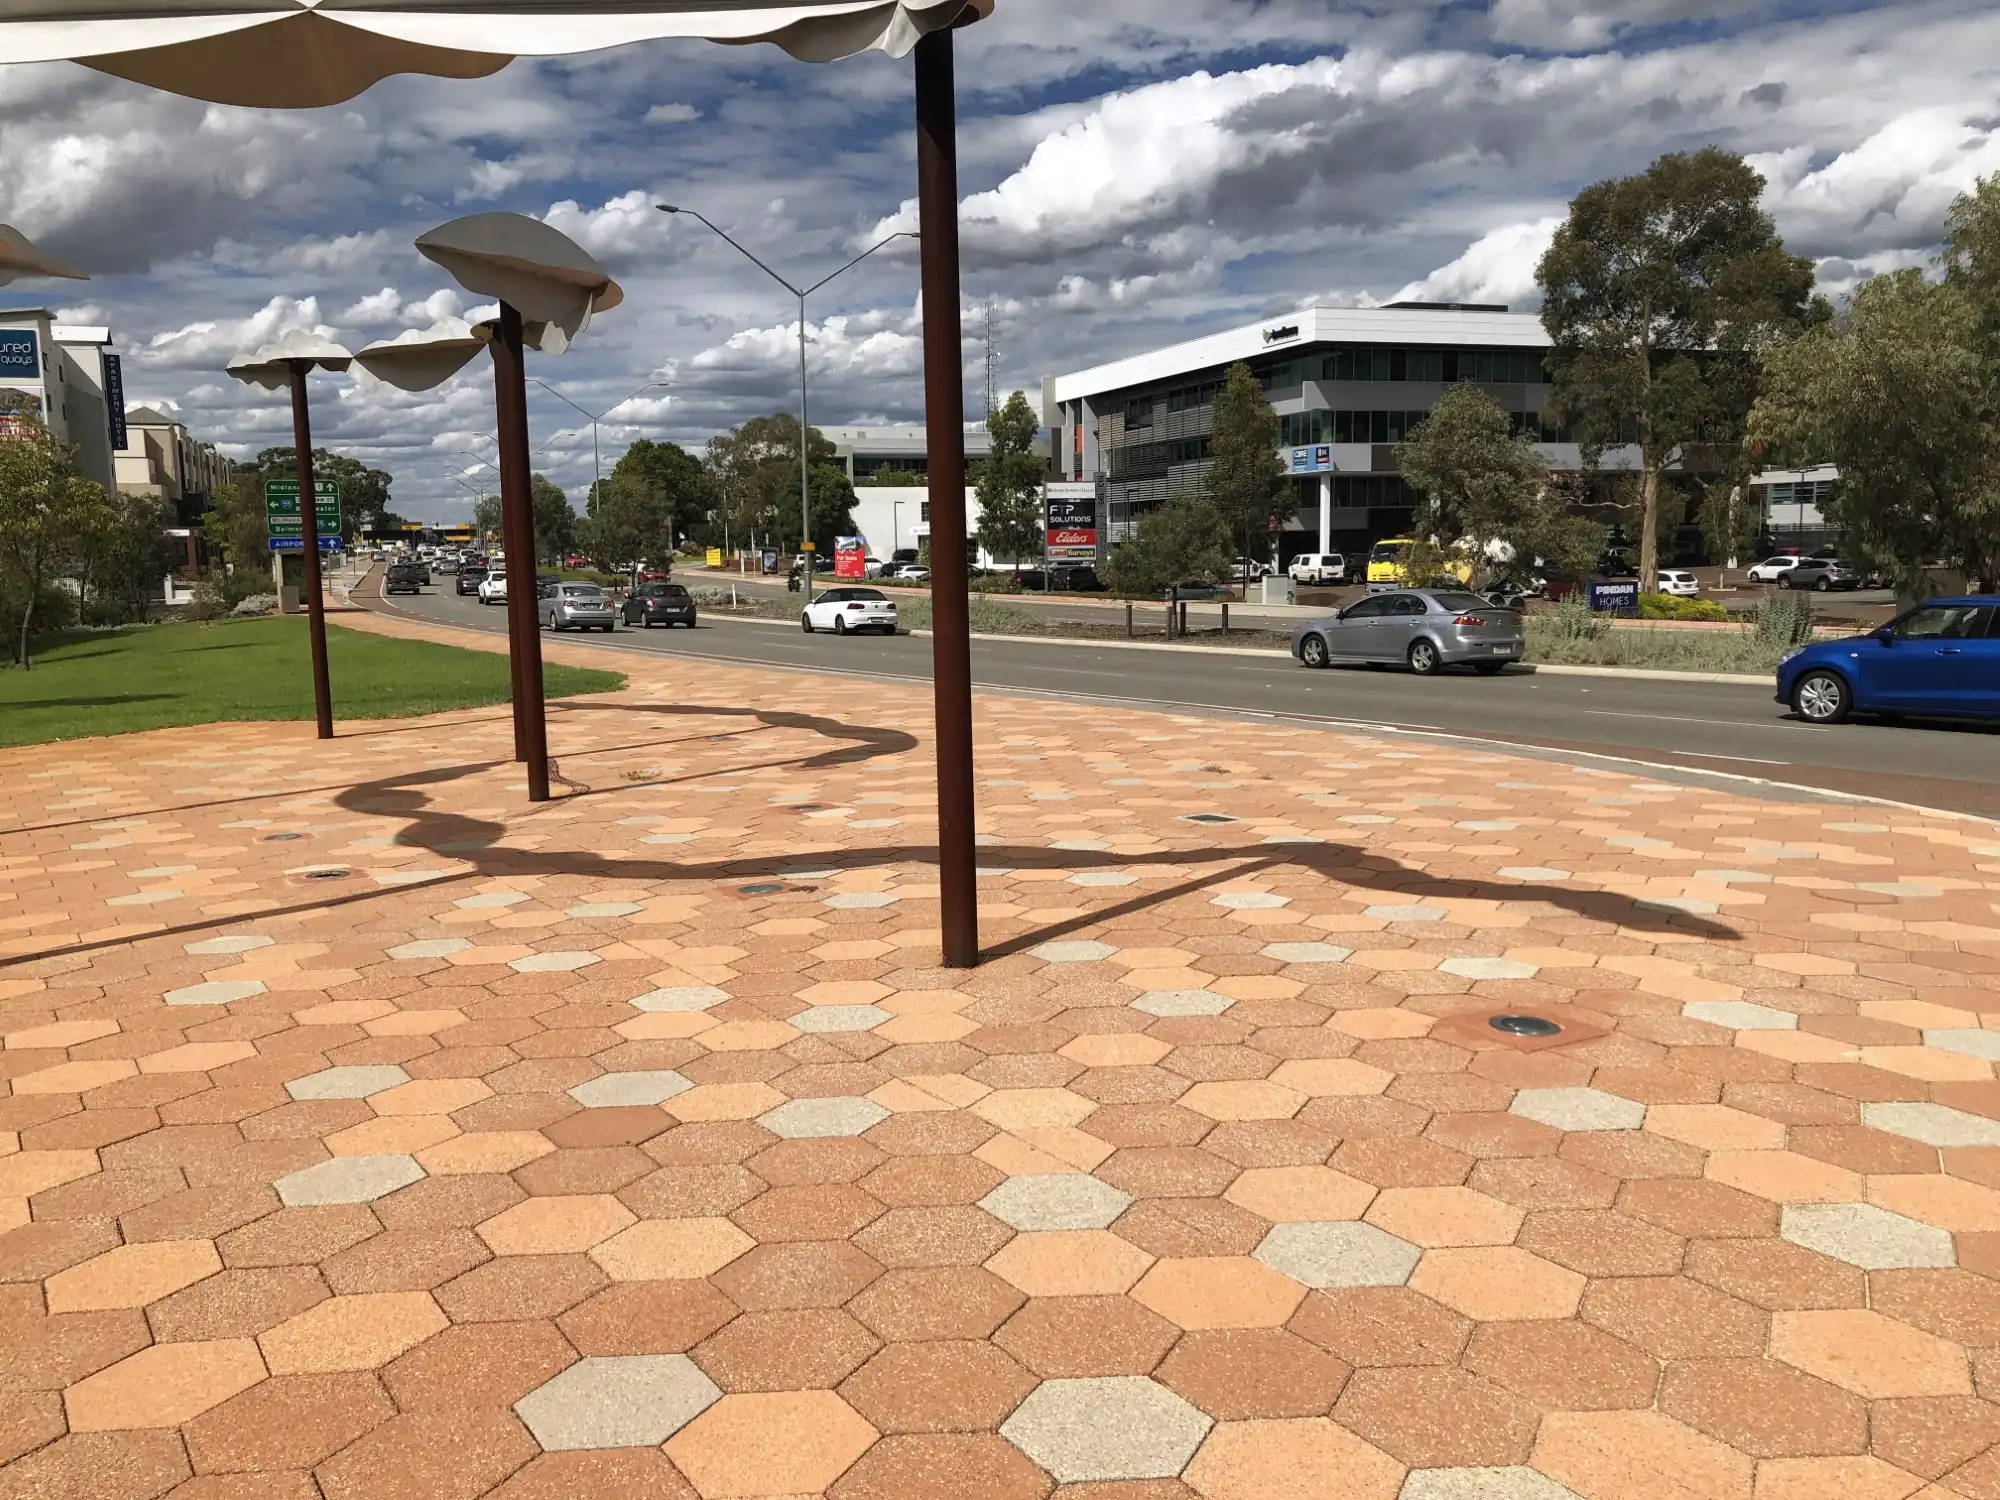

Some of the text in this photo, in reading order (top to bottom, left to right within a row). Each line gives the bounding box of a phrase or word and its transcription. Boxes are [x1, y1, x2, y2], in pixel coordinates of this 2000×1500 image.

[1, 355, 33, 365] quays
[109, 356, 124, 448] APARTMENT HOTEL
[1050, 505, 1075, 515] FTP
[1056, 532, 1088, 543] Elders
[1596, 585, 1634, 594] PINDAN
[1600, 596, 1629, 605] HOMES
